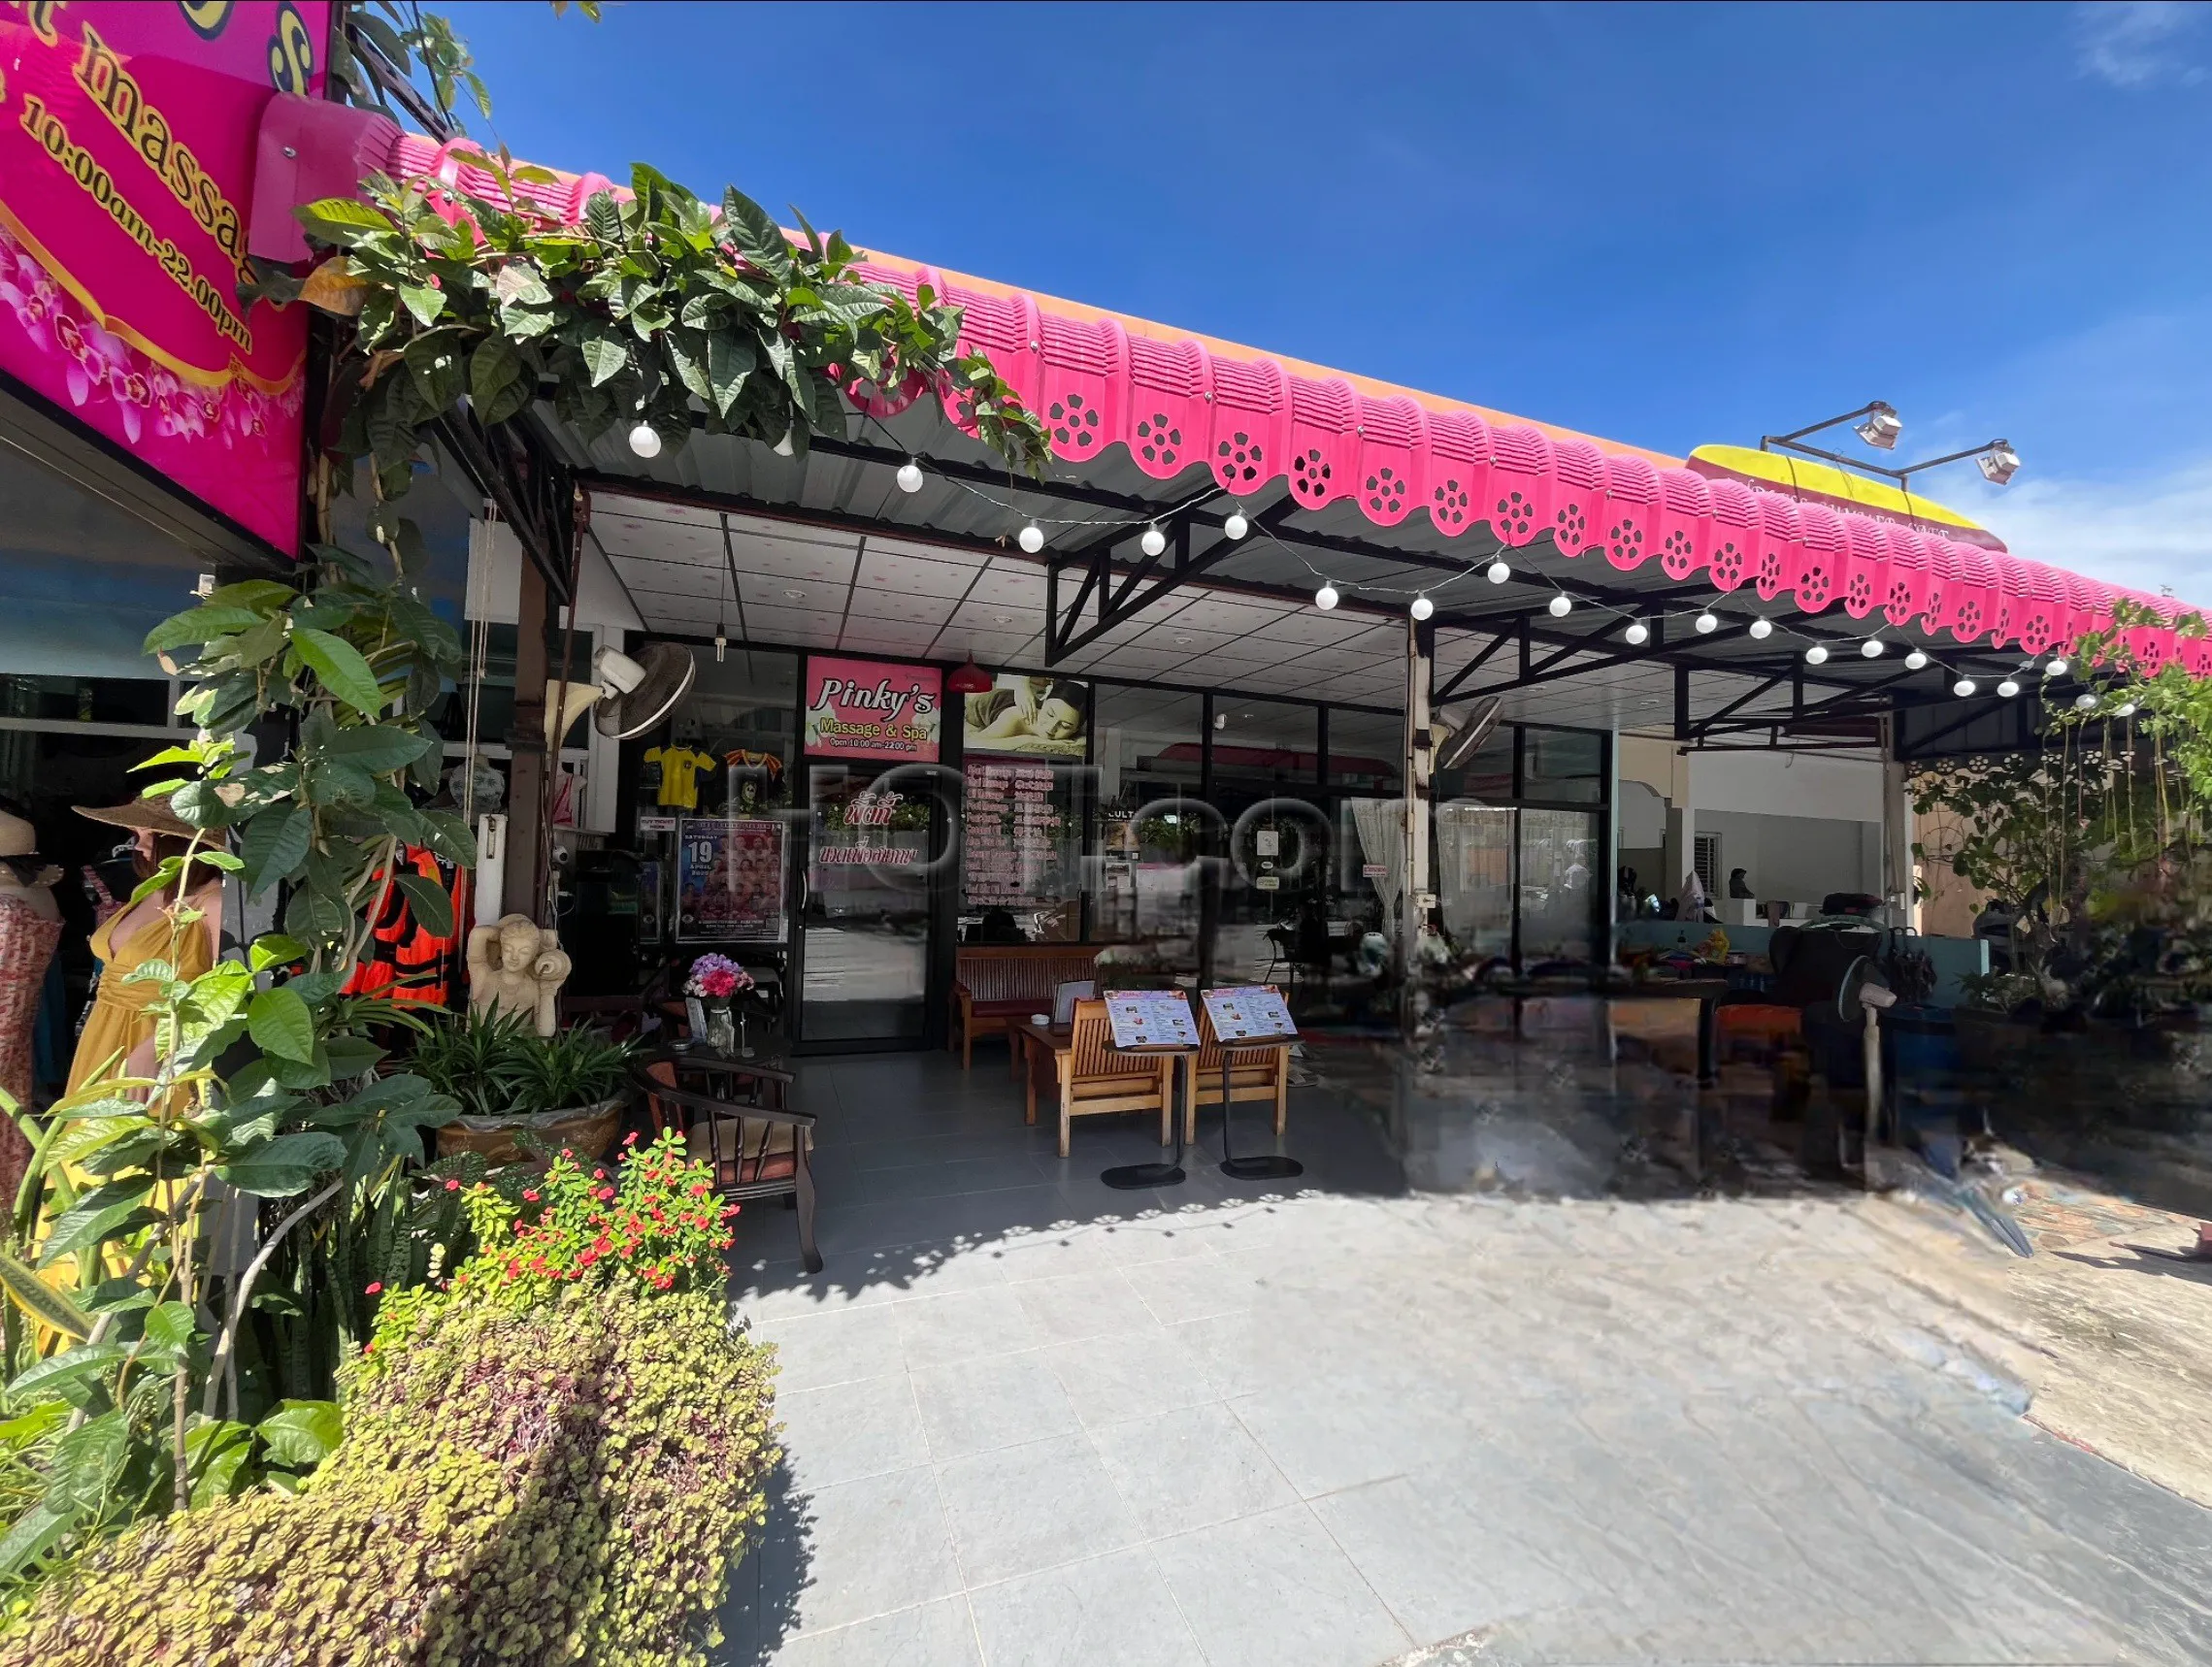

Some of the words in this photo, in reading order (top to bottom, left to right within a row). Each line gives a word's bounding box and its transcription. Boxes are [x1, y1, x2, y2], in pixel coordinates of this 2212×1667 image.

[810, 678, 936, 722] Pinky's
[820, 718, 880, 738] Massage
[885, 724, 897, 737] &
[902, 725, 928, 740] Spa
[830, 737, 847, 748] Open
[688, 841, 712, 863] 19
